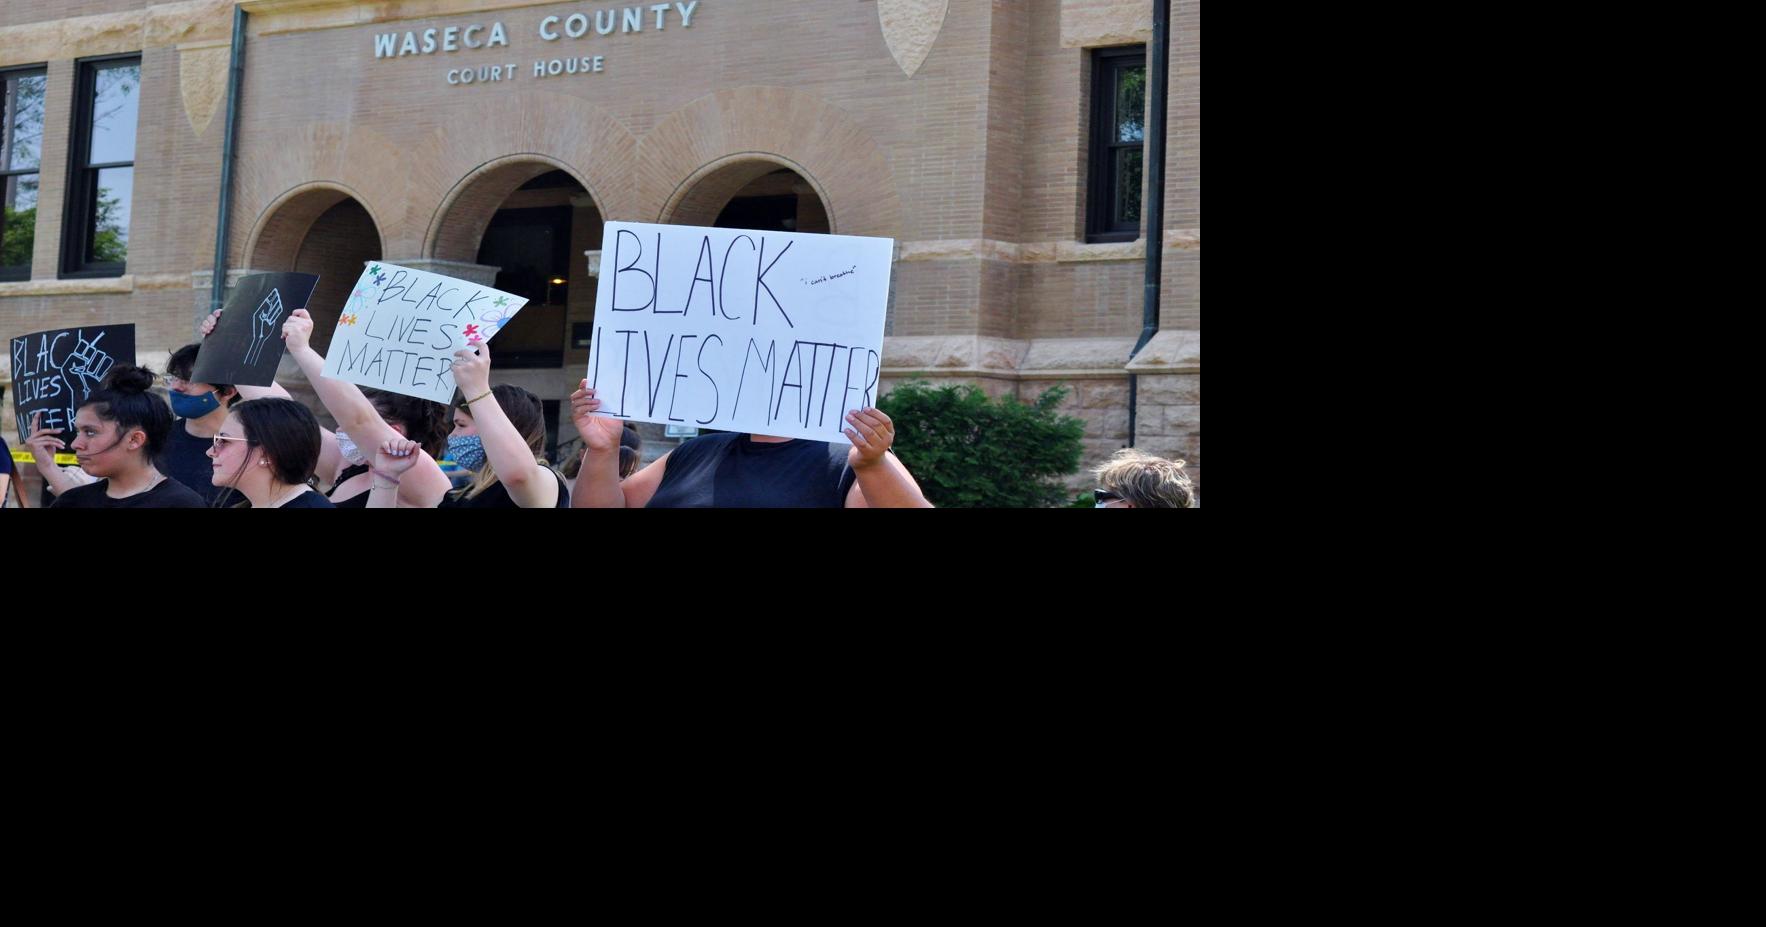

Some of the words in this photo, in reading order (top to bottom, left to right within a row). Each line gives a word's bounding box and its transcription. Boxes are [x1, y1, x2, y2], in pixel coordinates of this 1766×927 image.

[373, 22, 510, 58] WASECA
[538, 0, 699, 41] COUNTY
[446, 63, 518, 86] COURT
[533, 55, 605, 78] HOUSE
[376, 269, 489, 320] BLACK
[611, 229, 794, 328] BLACK
[364, 310, 458, 350] LIVES
[17, 374, 61, 406] LIVES
[336, 339, 453, 392] MATTER
[586, 325, 724, 424] LIVES
[731, 336, 880, 433] MATTER
